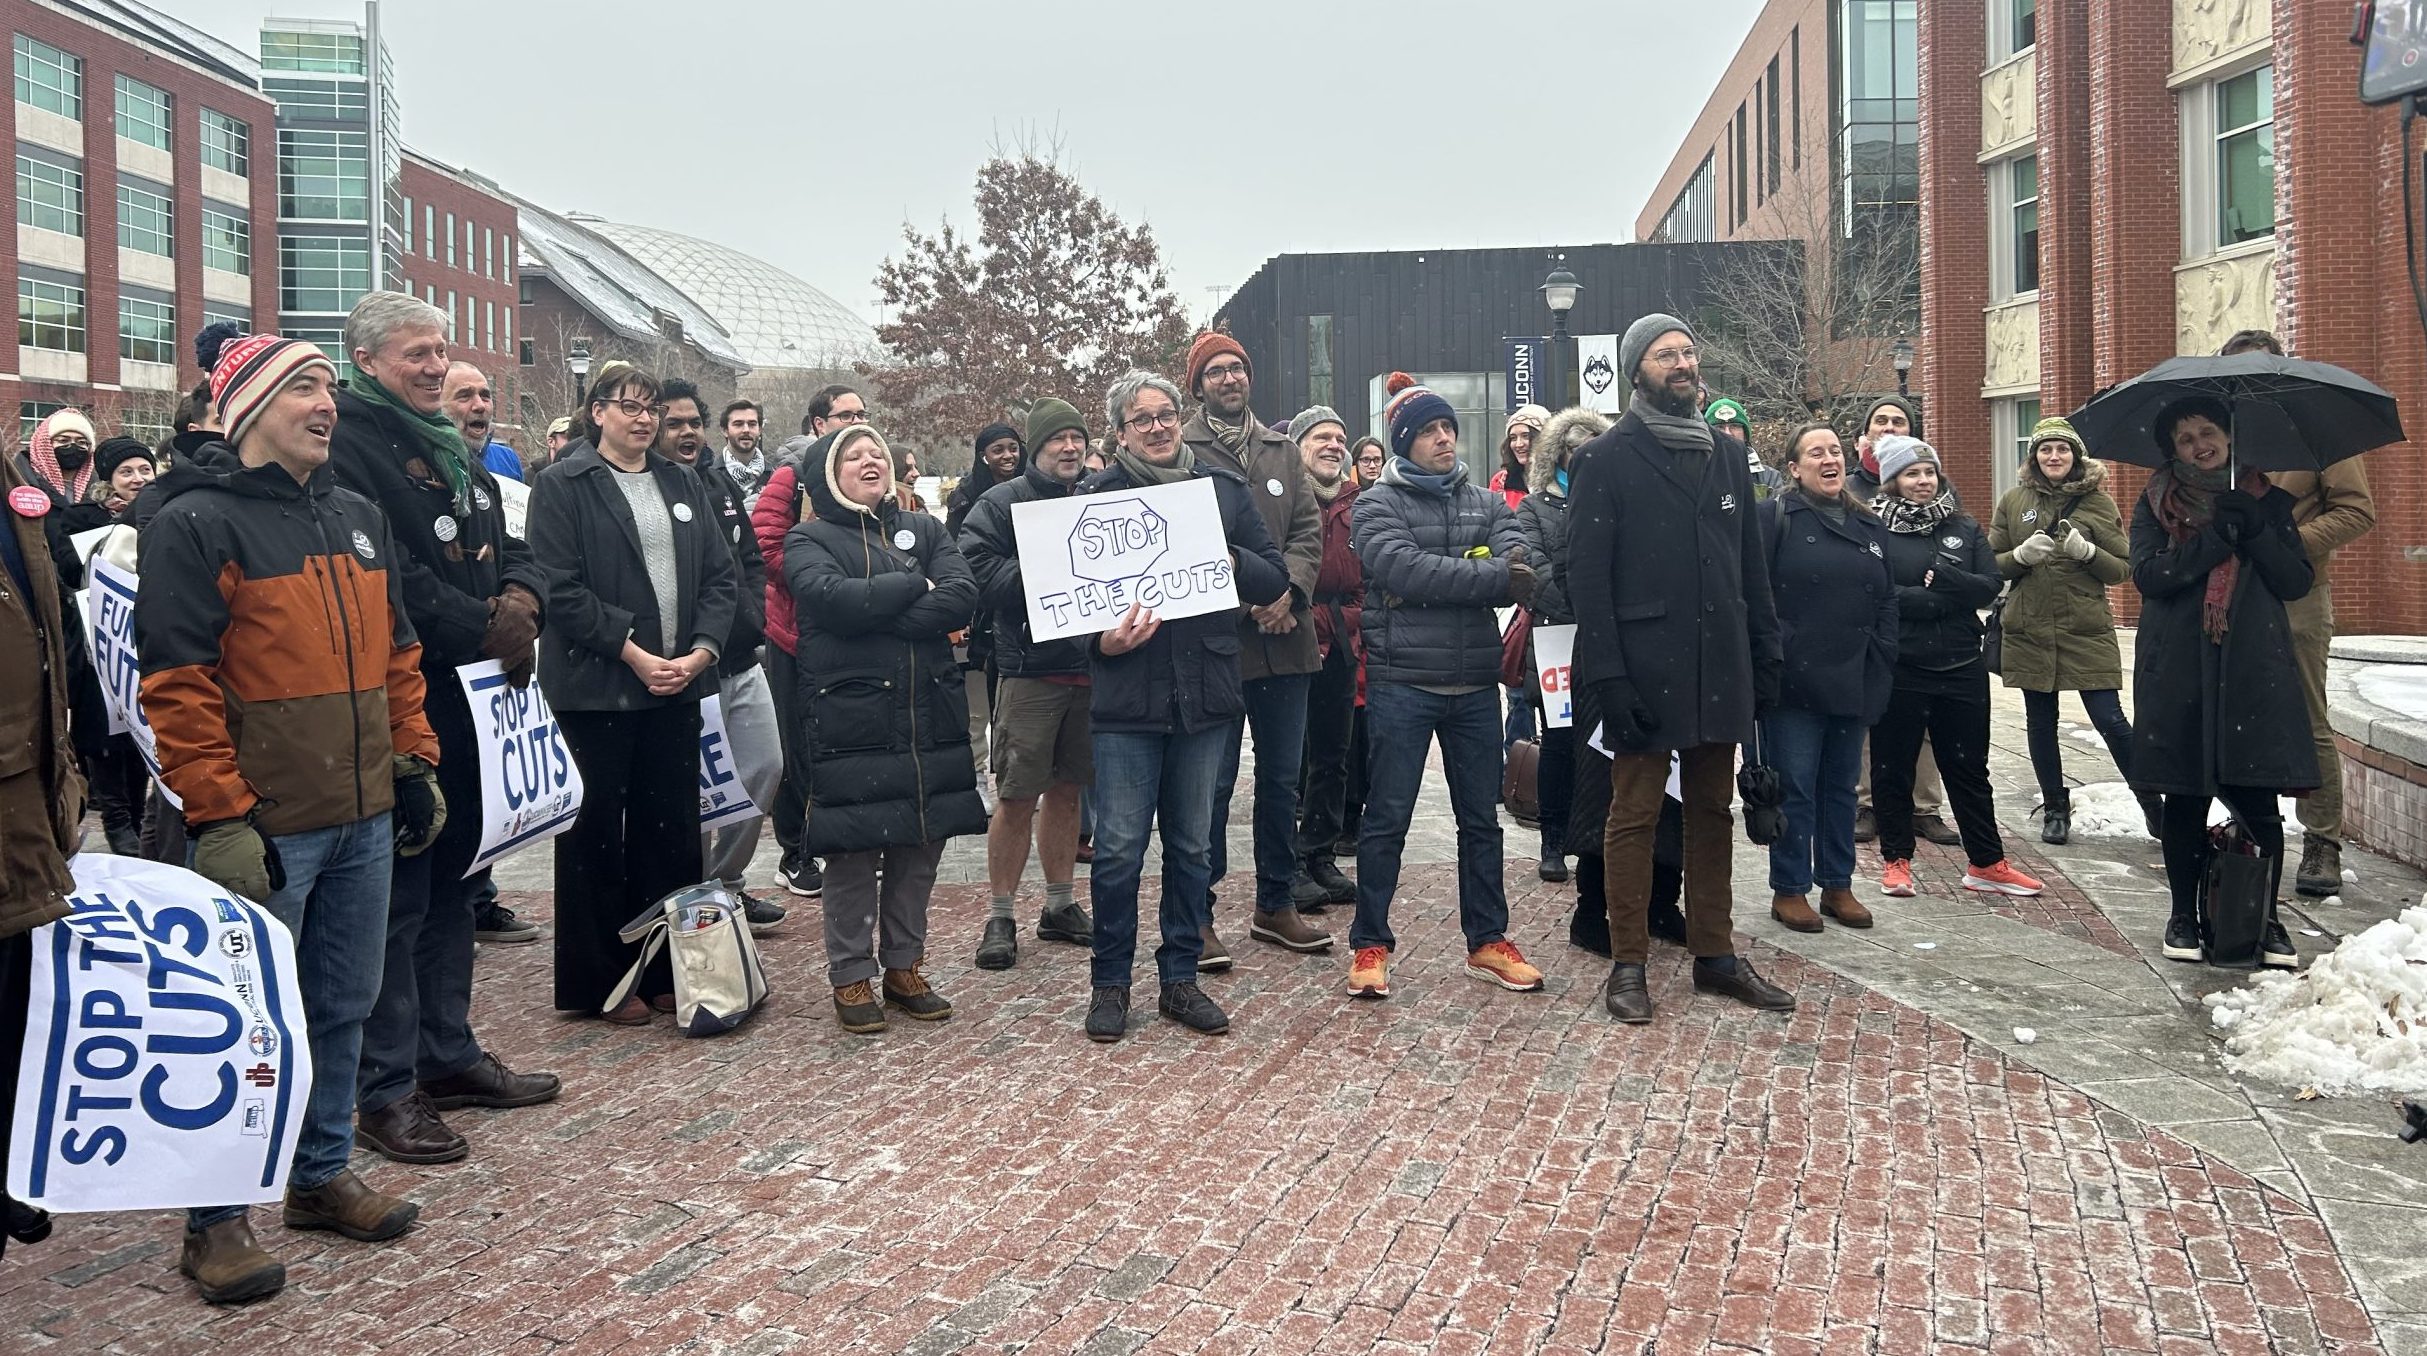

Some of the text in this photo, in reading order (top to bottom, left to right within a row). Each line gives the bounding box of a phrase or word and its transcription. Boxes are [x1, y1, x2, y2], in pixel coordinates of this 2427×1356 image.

[213, 340, 264, 391] ENTURE
[1515, 344, 1529, 408] UCONN
[1077, 510, 1165, 560] STOP
[101, 592, 136, 650] FUN
[1039, 559, 1231, 628] THE CUTS
[502, 720, 568, 811] CUTS
[60, 893, 143, 1167] STOP THE
[125, 898, 243, 1131] CUTS
